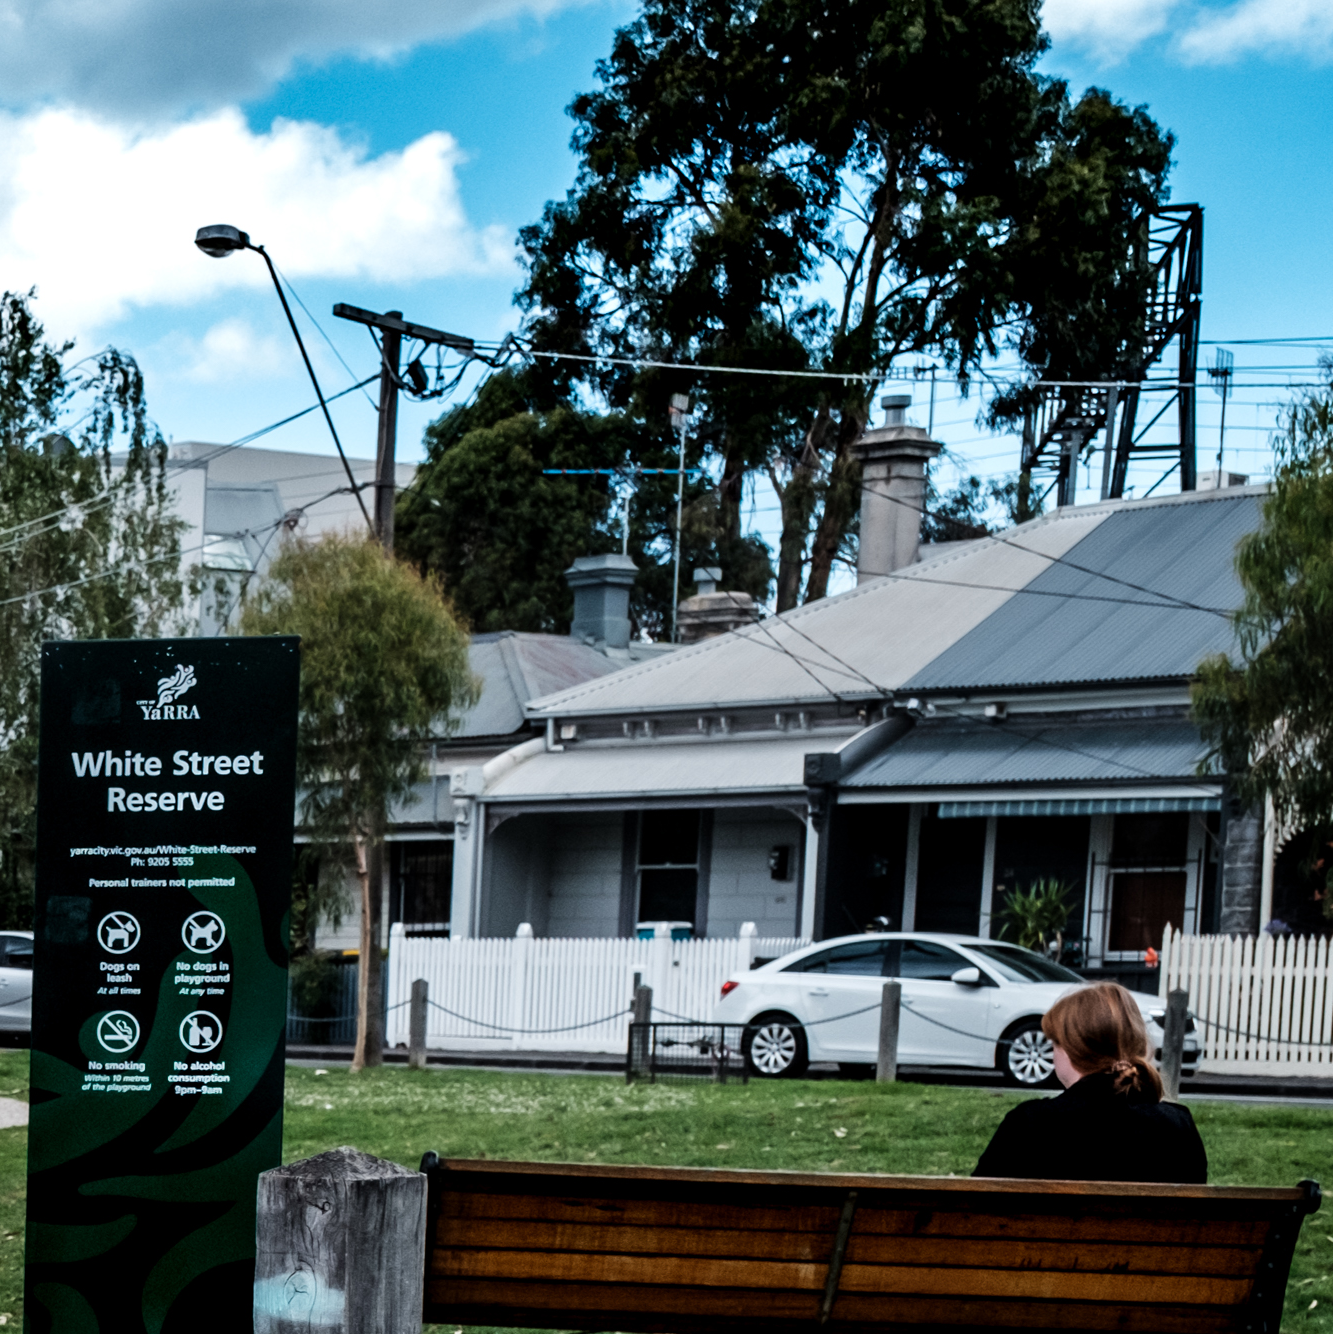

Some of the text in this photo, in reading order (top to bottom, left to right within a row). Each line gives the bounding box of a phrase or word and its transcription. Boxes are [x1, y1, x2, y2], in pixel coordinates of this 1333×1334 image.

[71, 750, 264, 778] White Street
[107, 787, 225, 812] Reserve
[70, 844, 257, 857] yarracity.vic.gov.au/White-Street-Reserve
[130, 856, 194, 867] Ph: 9205 5555
[88, 876, 235, 888] Personal trainers not permitted
[99, 962, 140, 972] Dogs on
[176, 961, 230, 973] No dogs in
[107, 973, 132, 982] leash
[174, 973, 231, 984] playground
[97, 987, 141, 995] At all times
[179, 987, 225, 997] At any time
[88, 1061, 146, 1073] No smoking
[174, 1061, 226, 1071] No alcohol
[84, 1074, 150, 1082] Within 10 metres
[167, 1074, 231, 1084] consumption
[81, 1083, 152, 1092] of the playground
[174, 1085, 223, 1096] 9pm–9am
